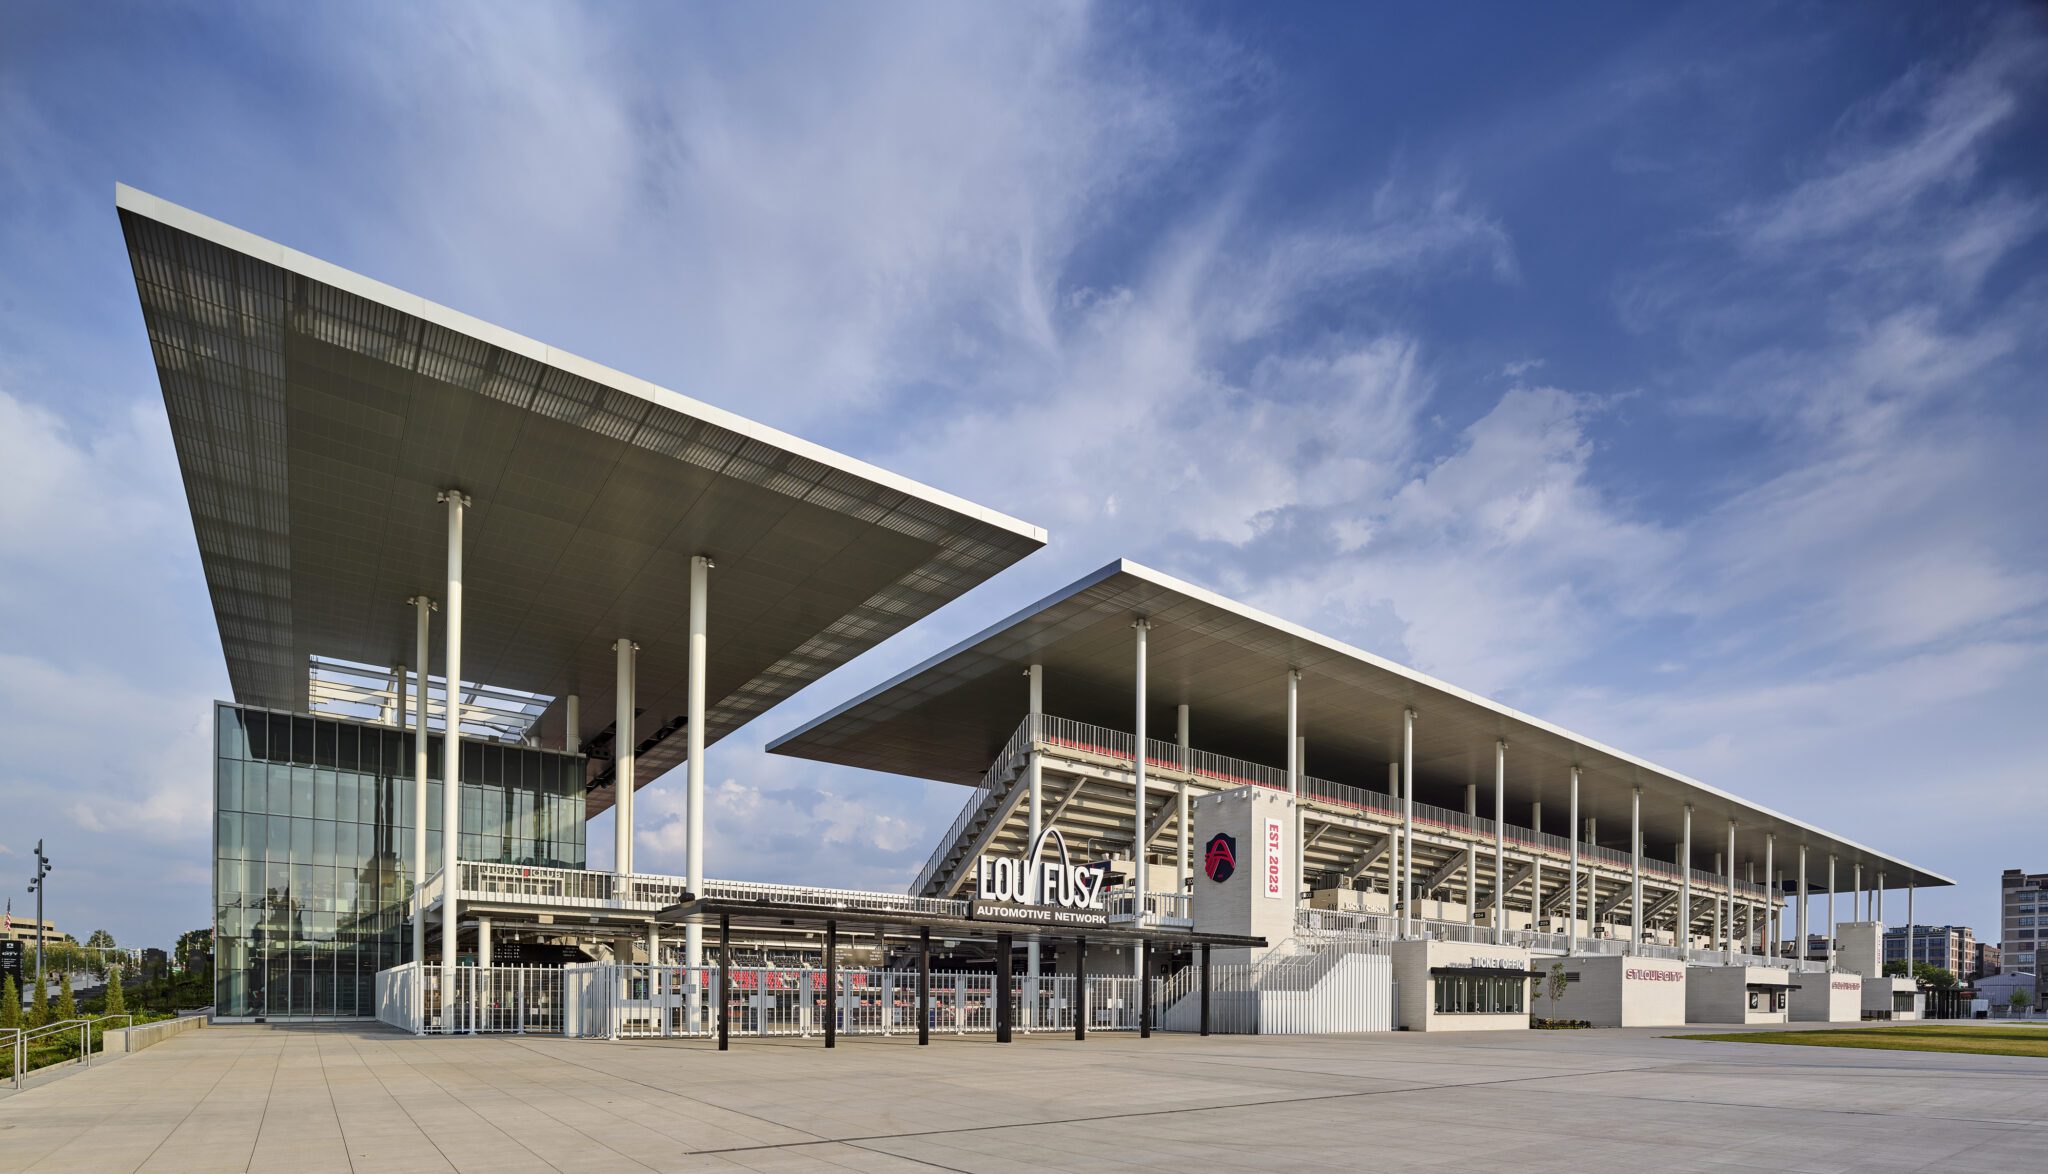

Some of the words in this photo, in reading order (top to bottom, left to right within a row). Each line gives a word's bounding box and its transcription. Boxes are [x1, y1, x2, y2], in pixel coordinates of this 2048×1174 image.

[1269, 824, 1279, 852] EST.
[979, 854, 1032, 904] LOU
[1043, 862, 1104, 909] FUSZ
[1269, 856, 1279, 893] 2023
[976, 906, 1051, 920] AUTOMOTIVE
[1055, 911, 1107, 924] NETWORK
[1473, 957, 1501, 969] TICKET
[1502, 959, 1528, 971] OFFIC
[1639, 970, 1663, 981] LOUIS
